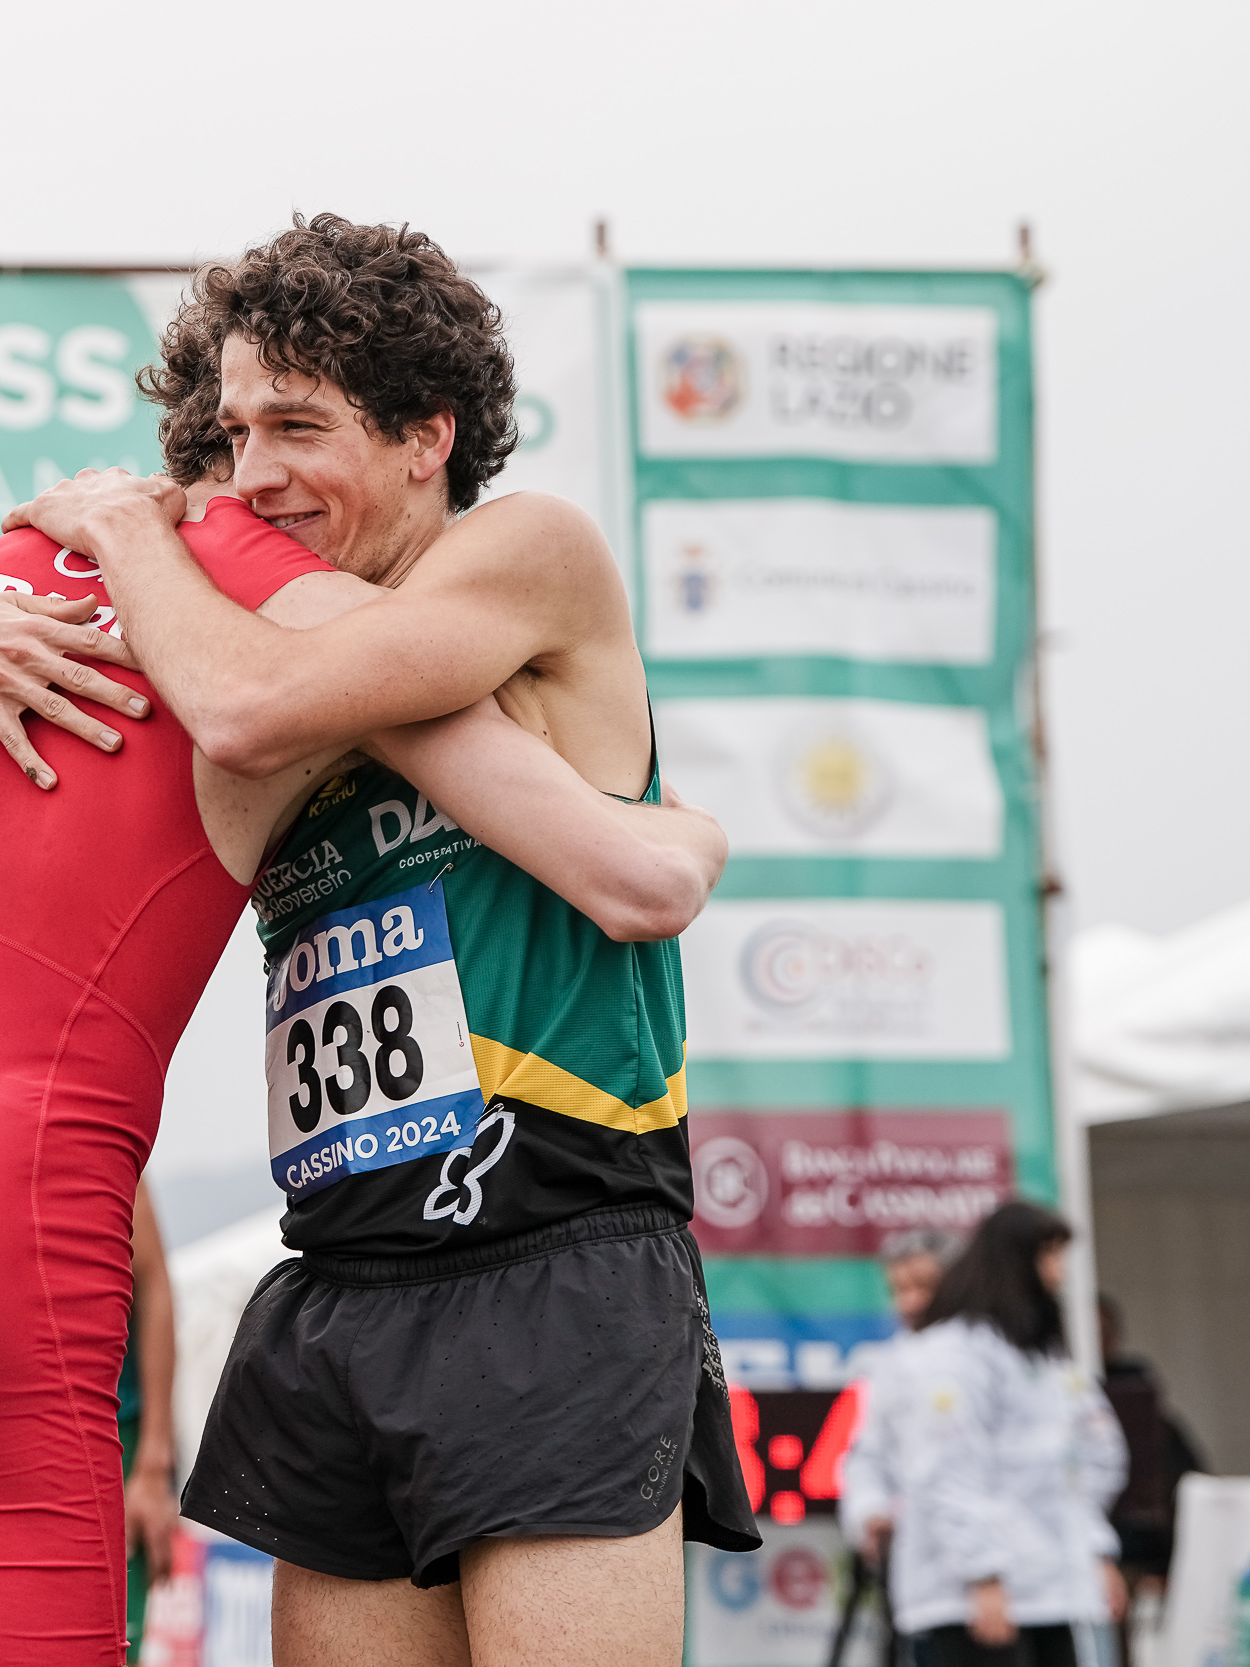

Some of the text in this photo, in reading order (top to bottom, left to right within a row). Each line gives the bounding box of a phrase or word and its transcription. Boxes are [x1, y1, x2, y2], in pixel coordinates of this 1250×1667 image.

[767, 333, 976, 382] REGIONE
[308, 780, 356, 818] KAHU
[398, 837, 482, 869] COOPERATIVA
[286, 984, 425, 1134] 338
[286, 1110, 463, 1189] CASSINO 2024
[640, 1433, 672, 1500] GORE
[652, 1444, 678, 1507] RUNNING WEAR
